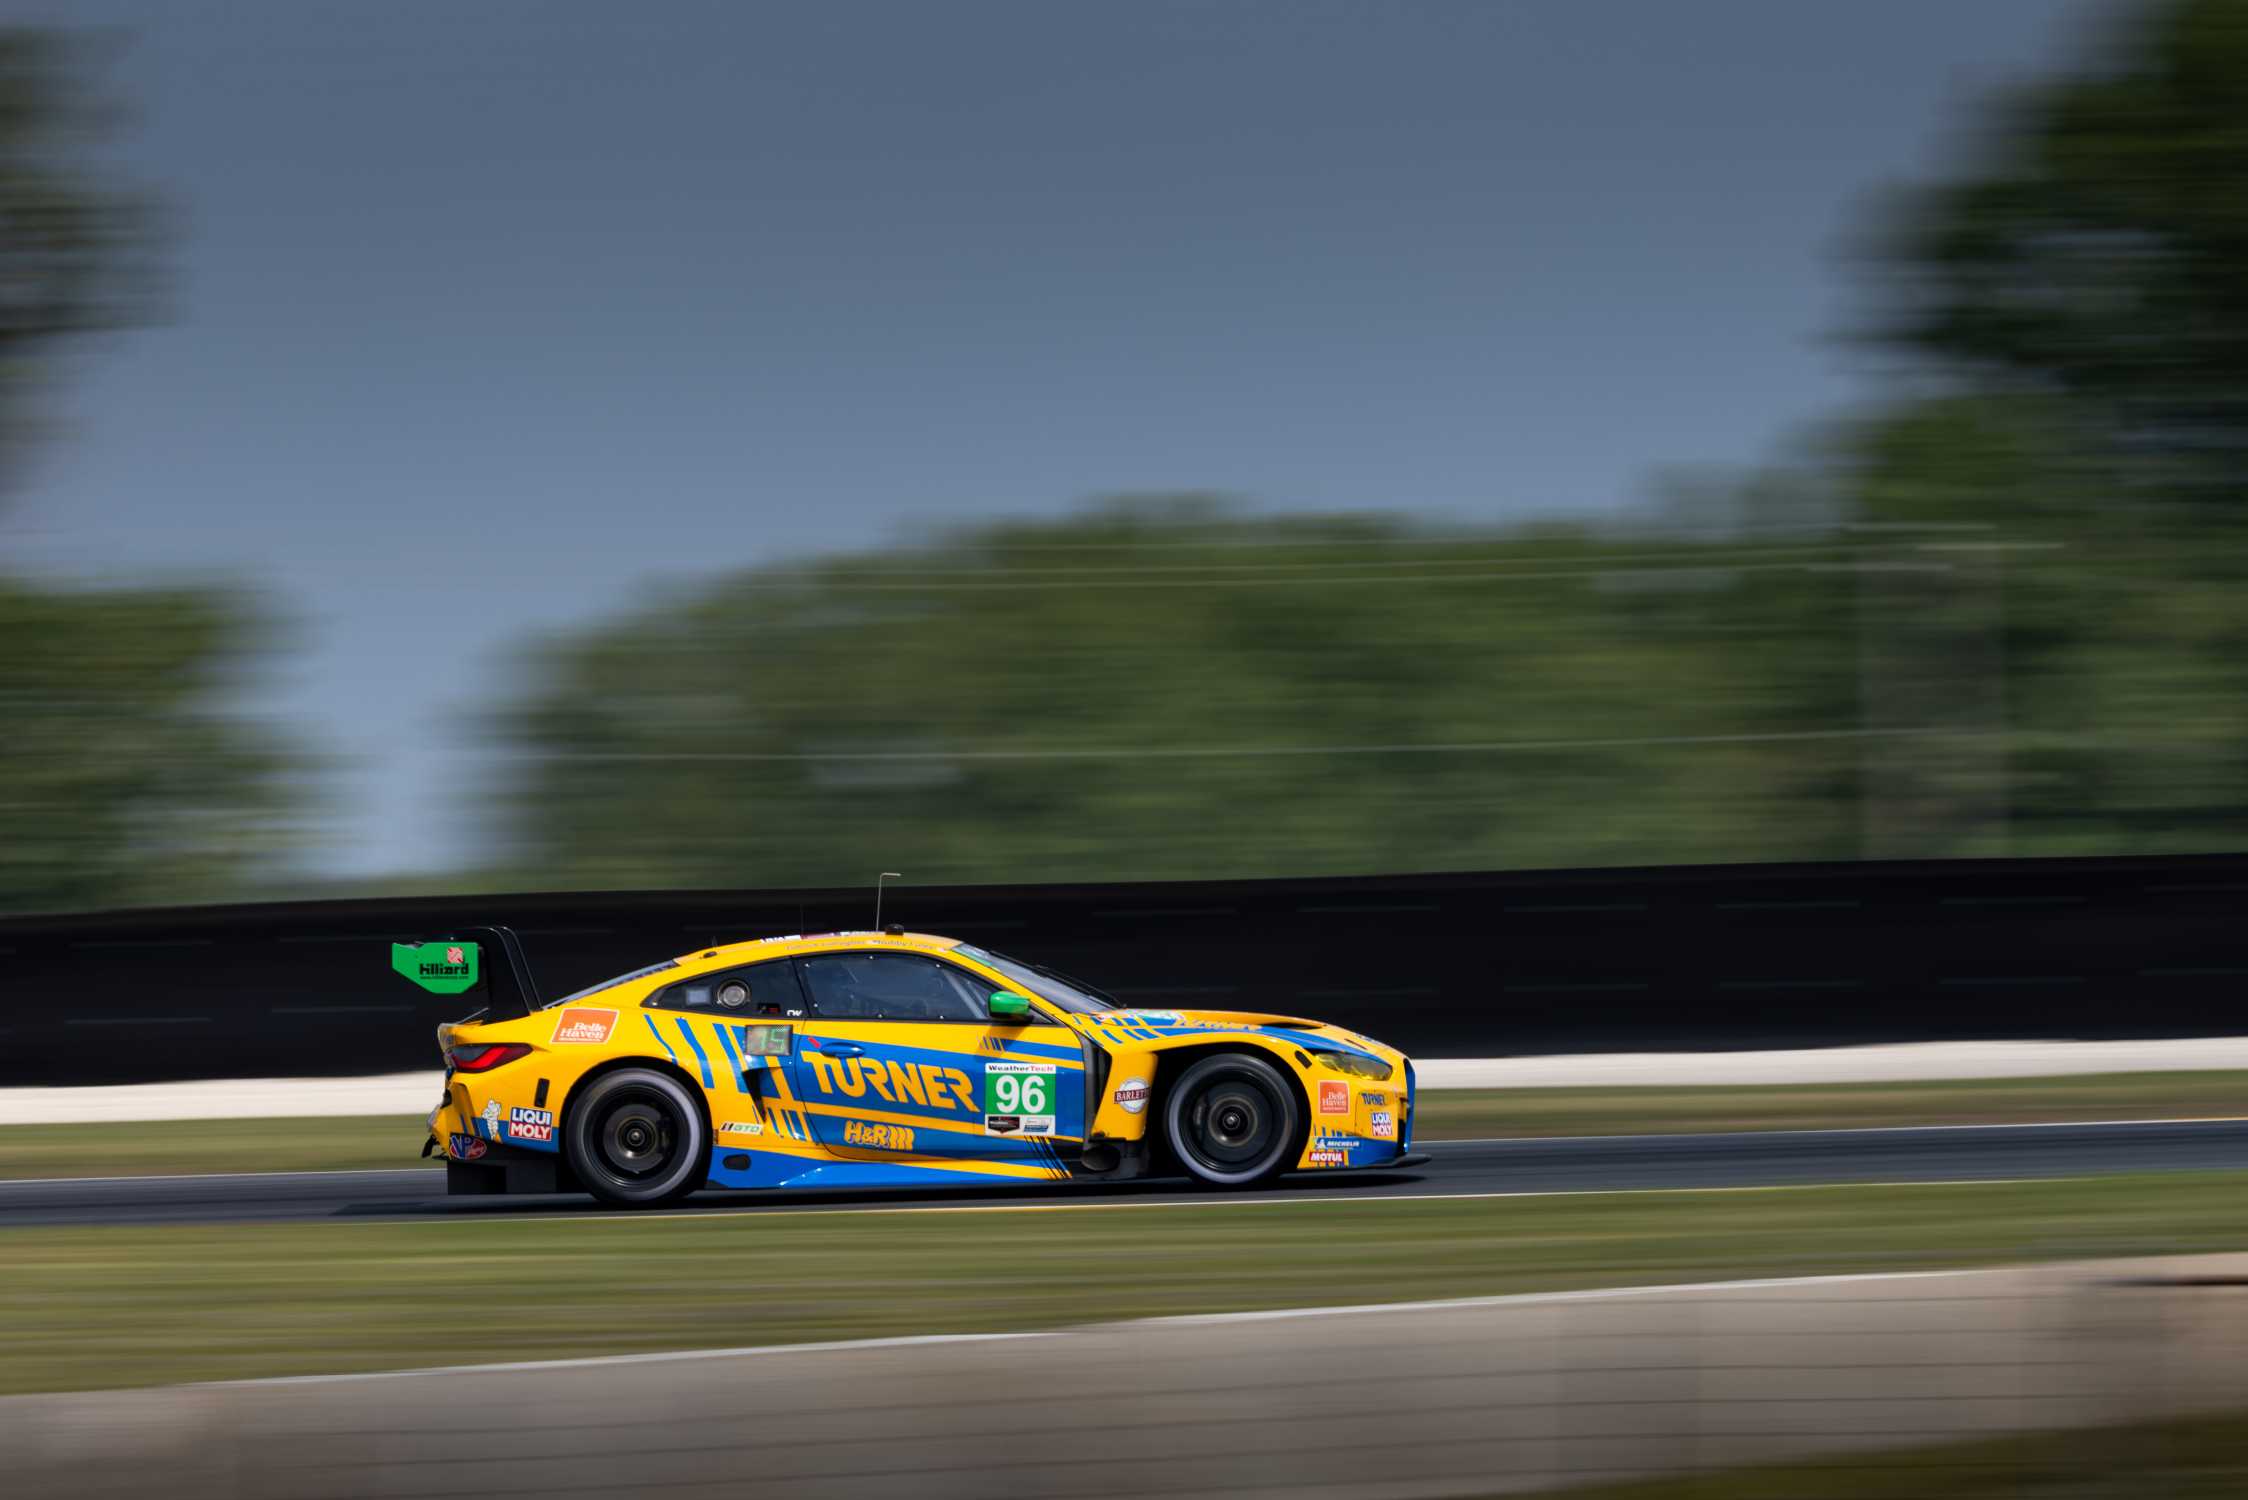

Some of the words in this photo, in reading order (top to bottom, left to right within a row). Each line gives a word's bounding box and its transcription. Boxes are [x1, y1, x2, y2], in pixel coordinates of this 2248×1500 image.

[988, 1064, 1054, 1072] WeatherTech
[800, 1050, 981, 1113] TURNER
[995, 1074, 1046, 1114] 96
[512, 1108, 551, 1125] LIQUI
[511, 1122, 550, 1140] MOLY
[1326, 1140, 1360, 1148] MICHELIN
[1310, 1152, 1343, 1162] MOTUL
